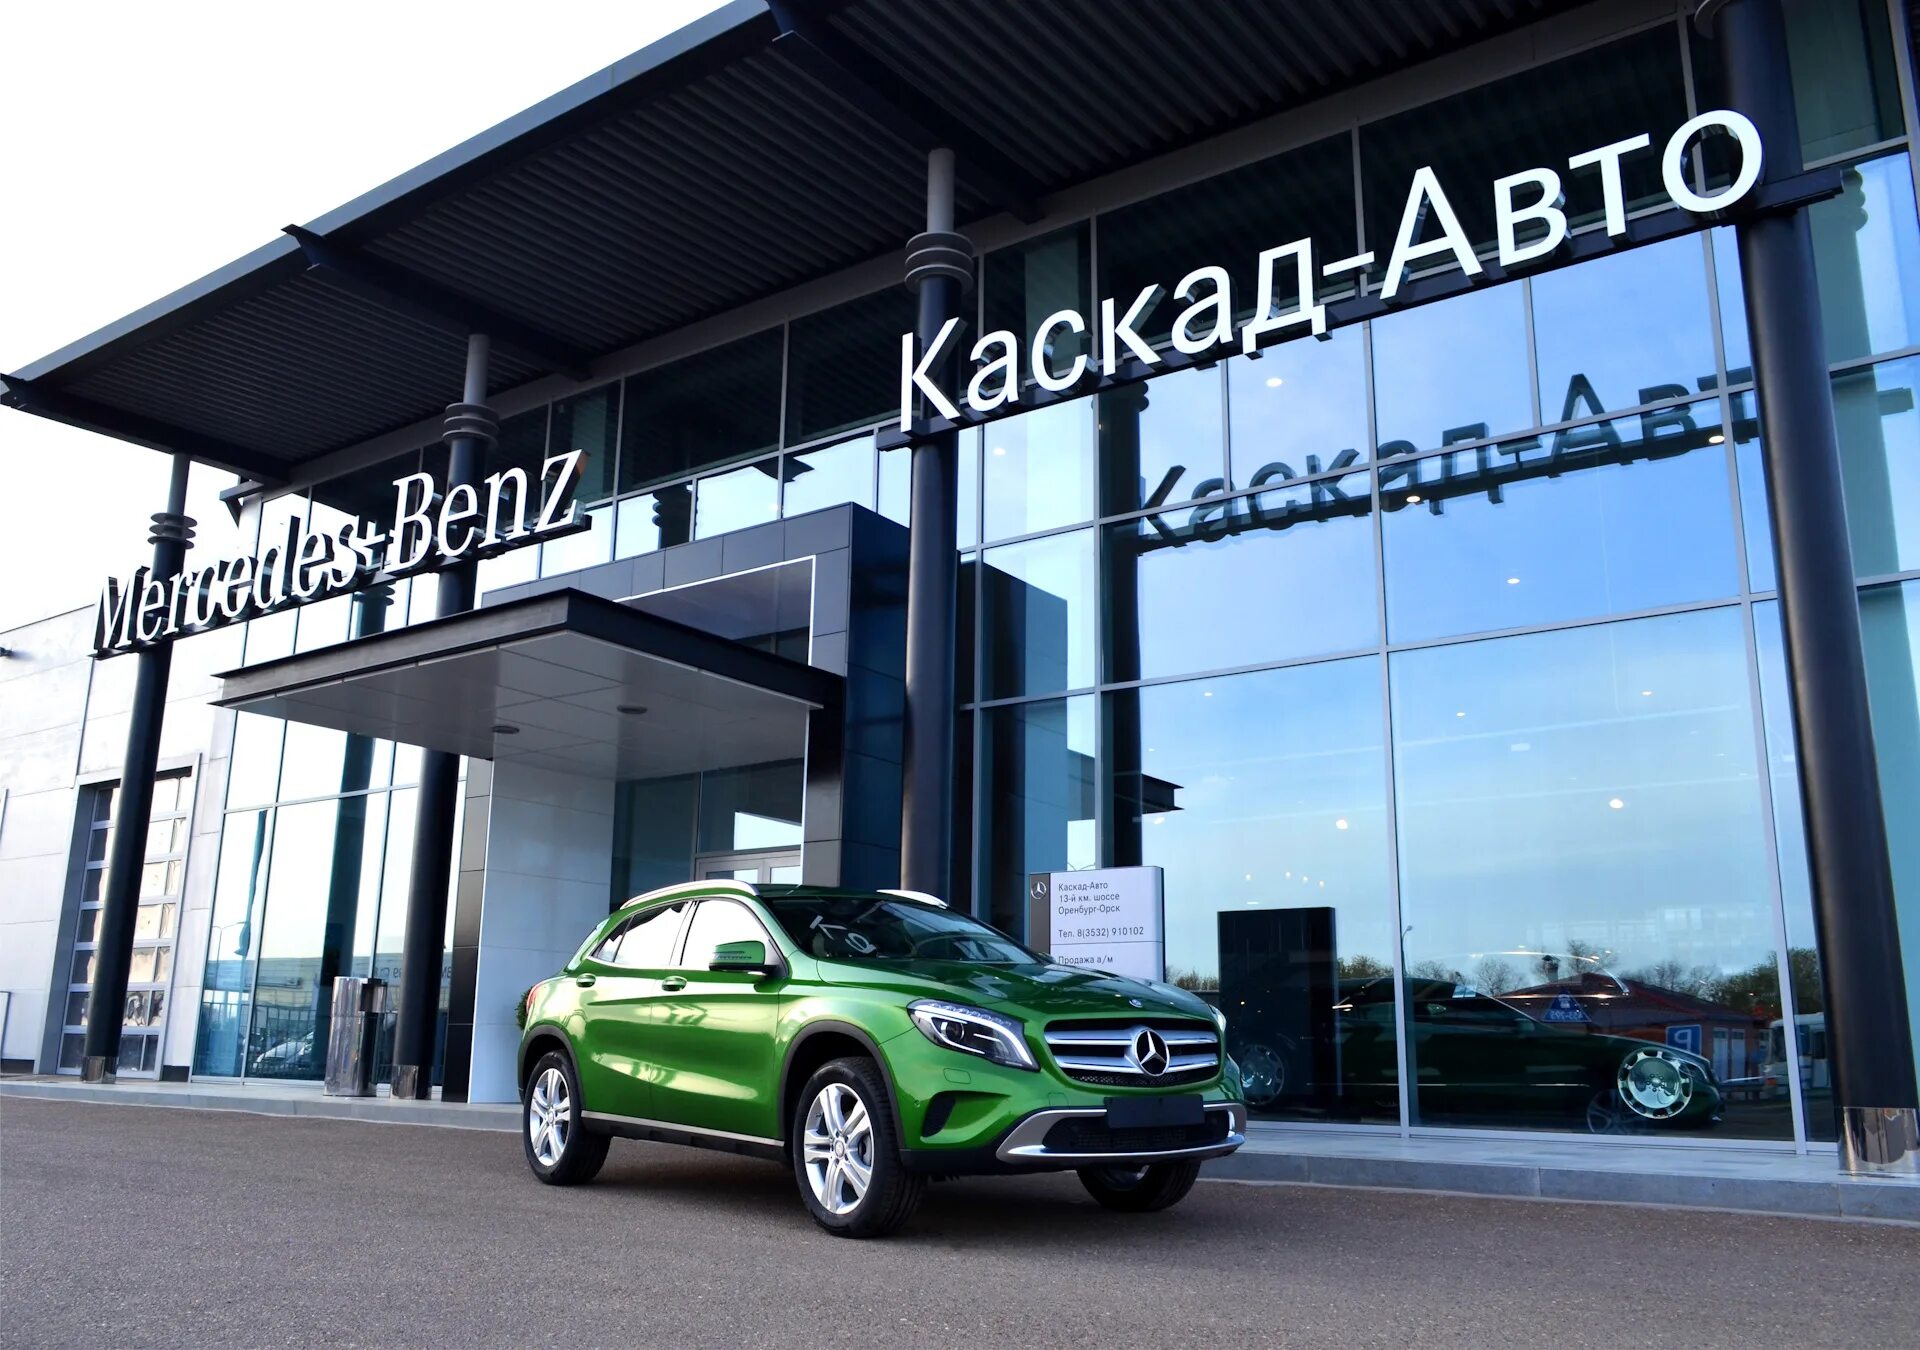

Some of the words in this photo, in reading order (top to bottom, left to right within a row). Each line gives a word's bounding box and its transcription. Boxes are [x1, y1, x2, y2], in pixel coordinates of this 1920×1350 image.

[900, 110, 1764, 433] Каскад-Авто
[1139, 366, 1758, 551] Каскад-Авт
[93, 448, 583, 651] Mercedes-Benz
[1058, 881, 1108, 891] Каскад-Авто
[1060, 893, 1076, 902] 13-й
[1094, 893, 1120, 901] шоссе
[1058, 904, 1120, 916] Оренбург-Орск
[1058, 929, 1074, 938] Тел.
[1077, 927, 1109, 938] 8(3532)
[1112, 926, 1144, 936] 910102
[1058, 955, 1095, 965] Продажа
[1096, 955, 1113, 964] а/м
